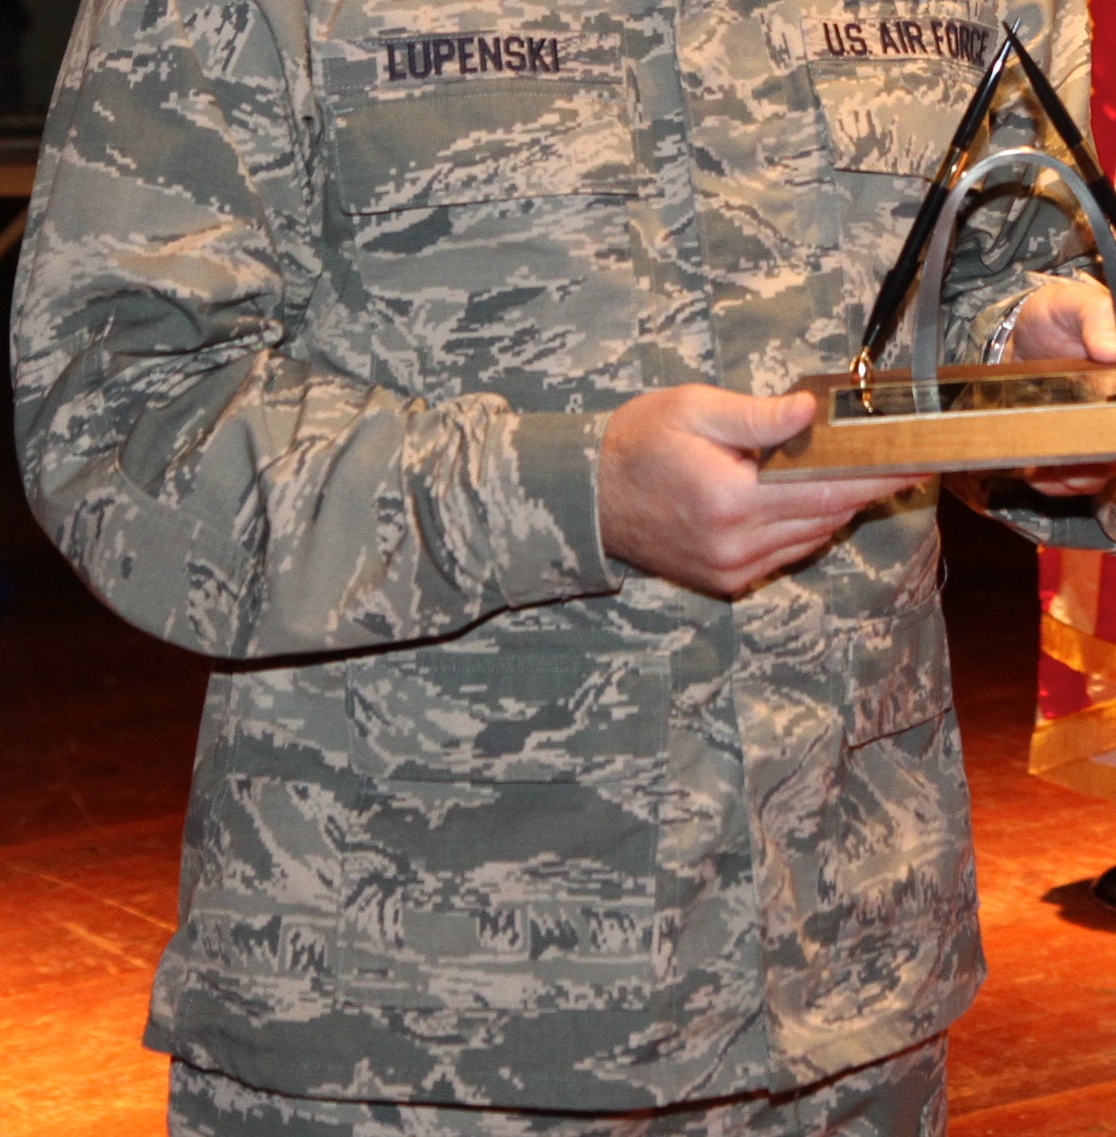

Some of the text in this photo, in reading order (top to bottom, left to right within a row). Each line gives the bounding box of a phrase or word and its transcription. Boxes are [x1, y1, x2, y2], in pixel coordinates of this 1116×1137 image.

[386, 36, 561, 82] LUPENSKI
[822, 21, 989, 66] U.S. AIR FORCE
